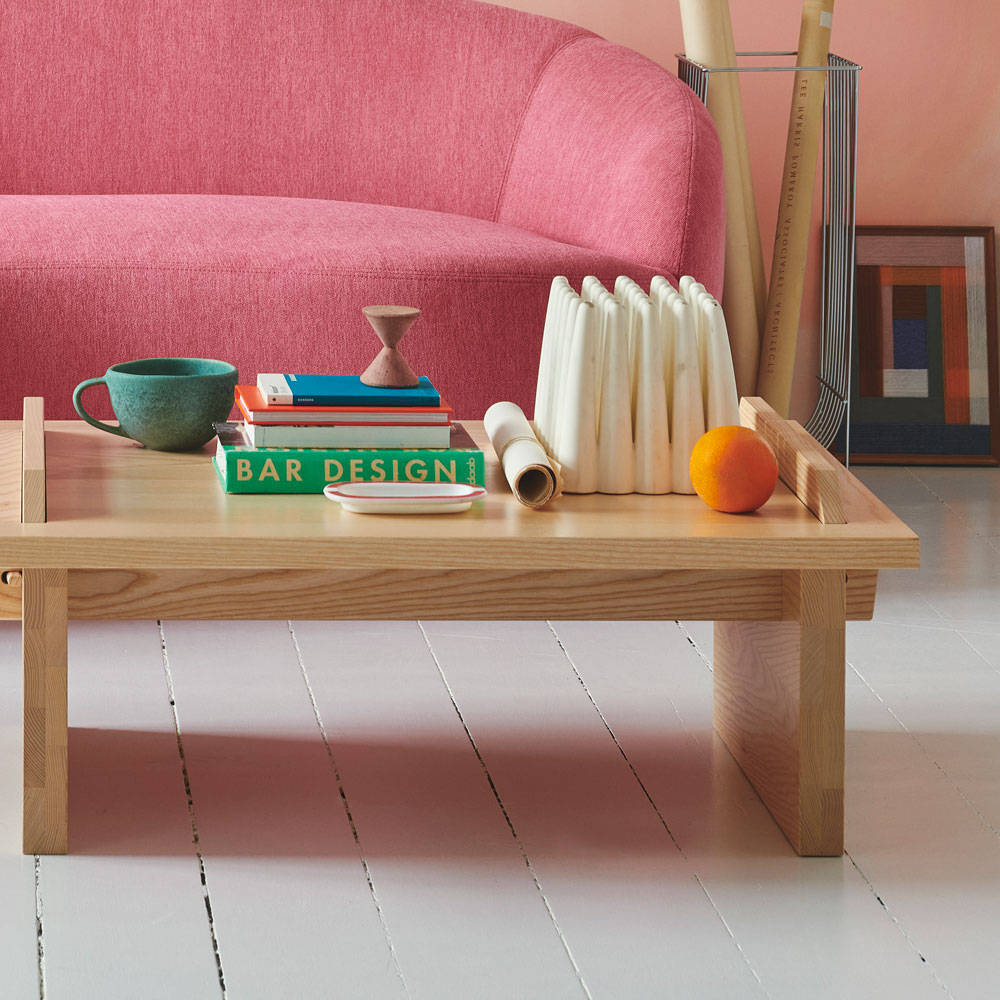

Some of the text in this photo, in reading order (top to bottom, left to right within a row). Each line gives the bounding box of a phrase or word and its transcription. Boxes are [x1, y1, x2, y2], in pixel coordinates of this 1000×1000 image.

[236, 458, 457, 484] BAR DESIGN
[466, 457, 476, 486] daab
